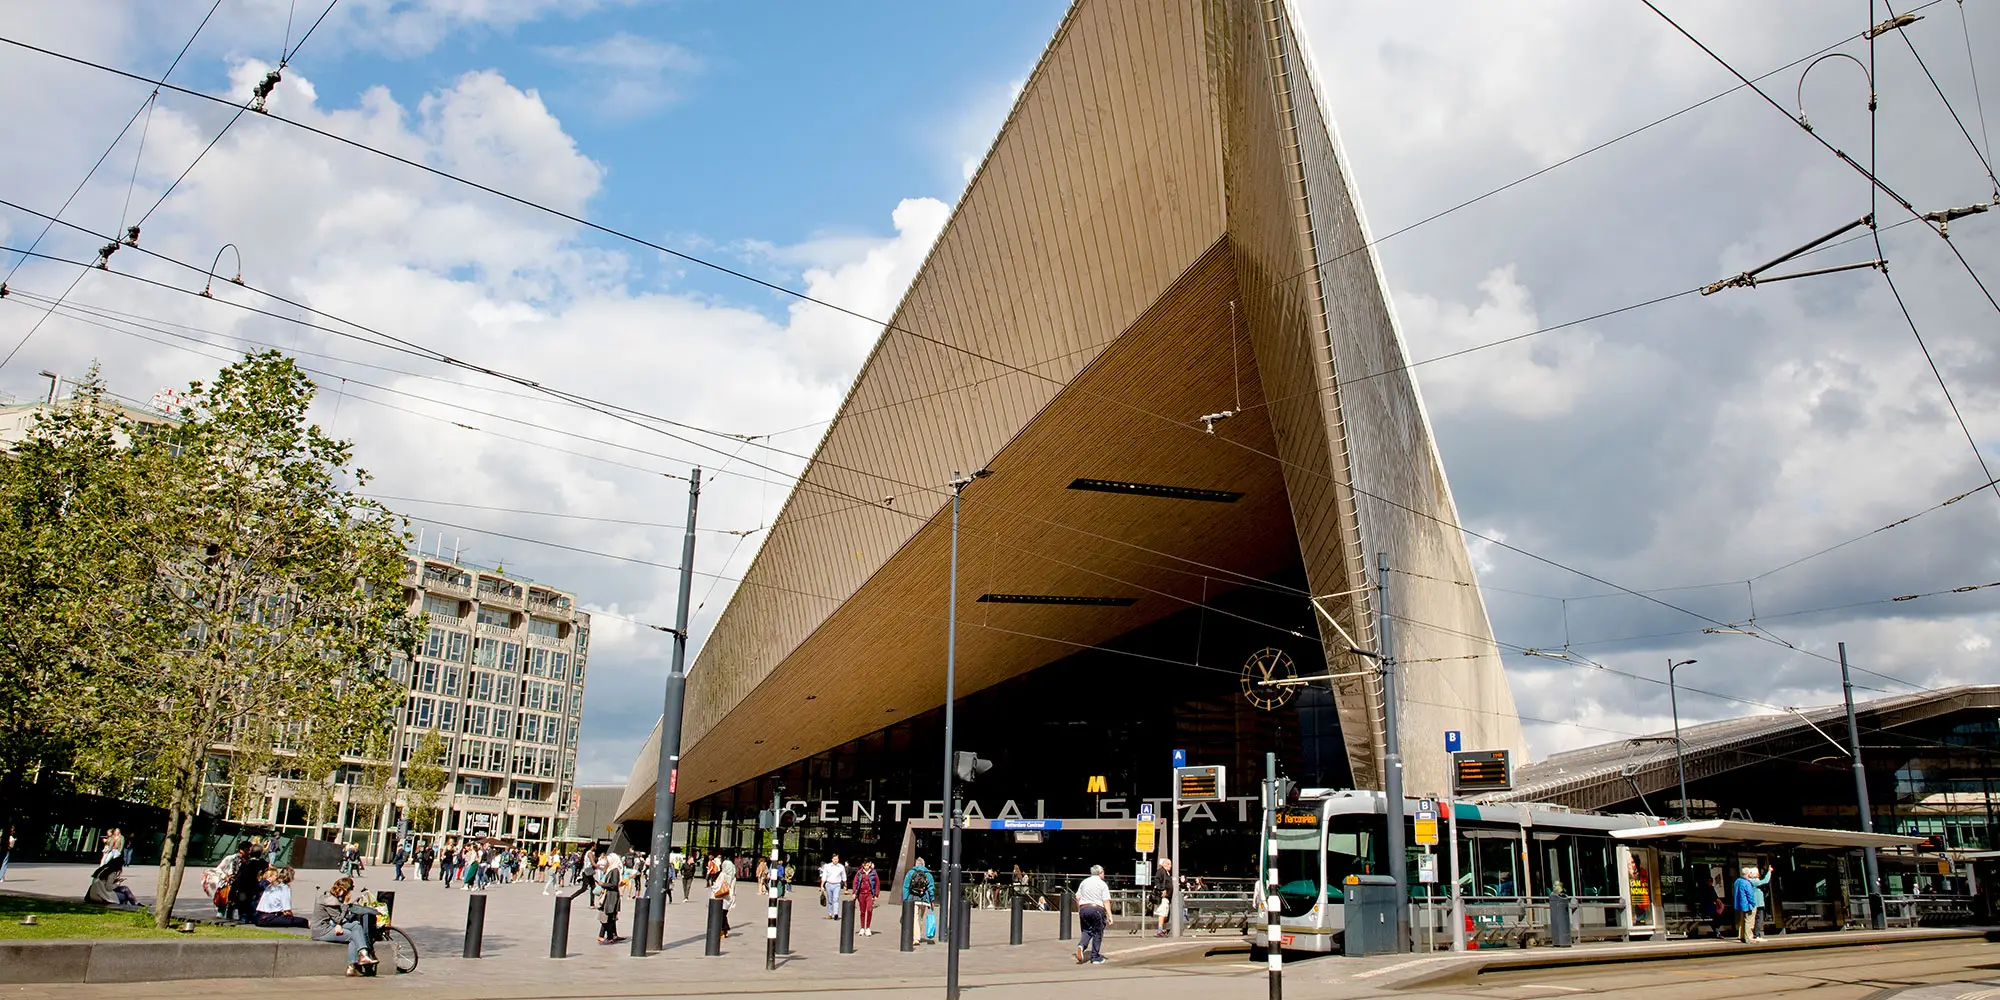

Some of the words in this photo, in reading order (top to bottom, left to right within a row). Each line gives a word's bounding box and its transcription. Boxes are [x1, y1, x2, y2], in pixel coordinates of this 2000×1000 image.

[1449, 733, 1456, 742] B
[1174, 751, 1182, 760] A
[1087, 776, 1108, 792] M
[1143, 804, 1150, 813] A
[1421, 801, 1428, 810] B
[1280, 935, 1296, 946] ET
